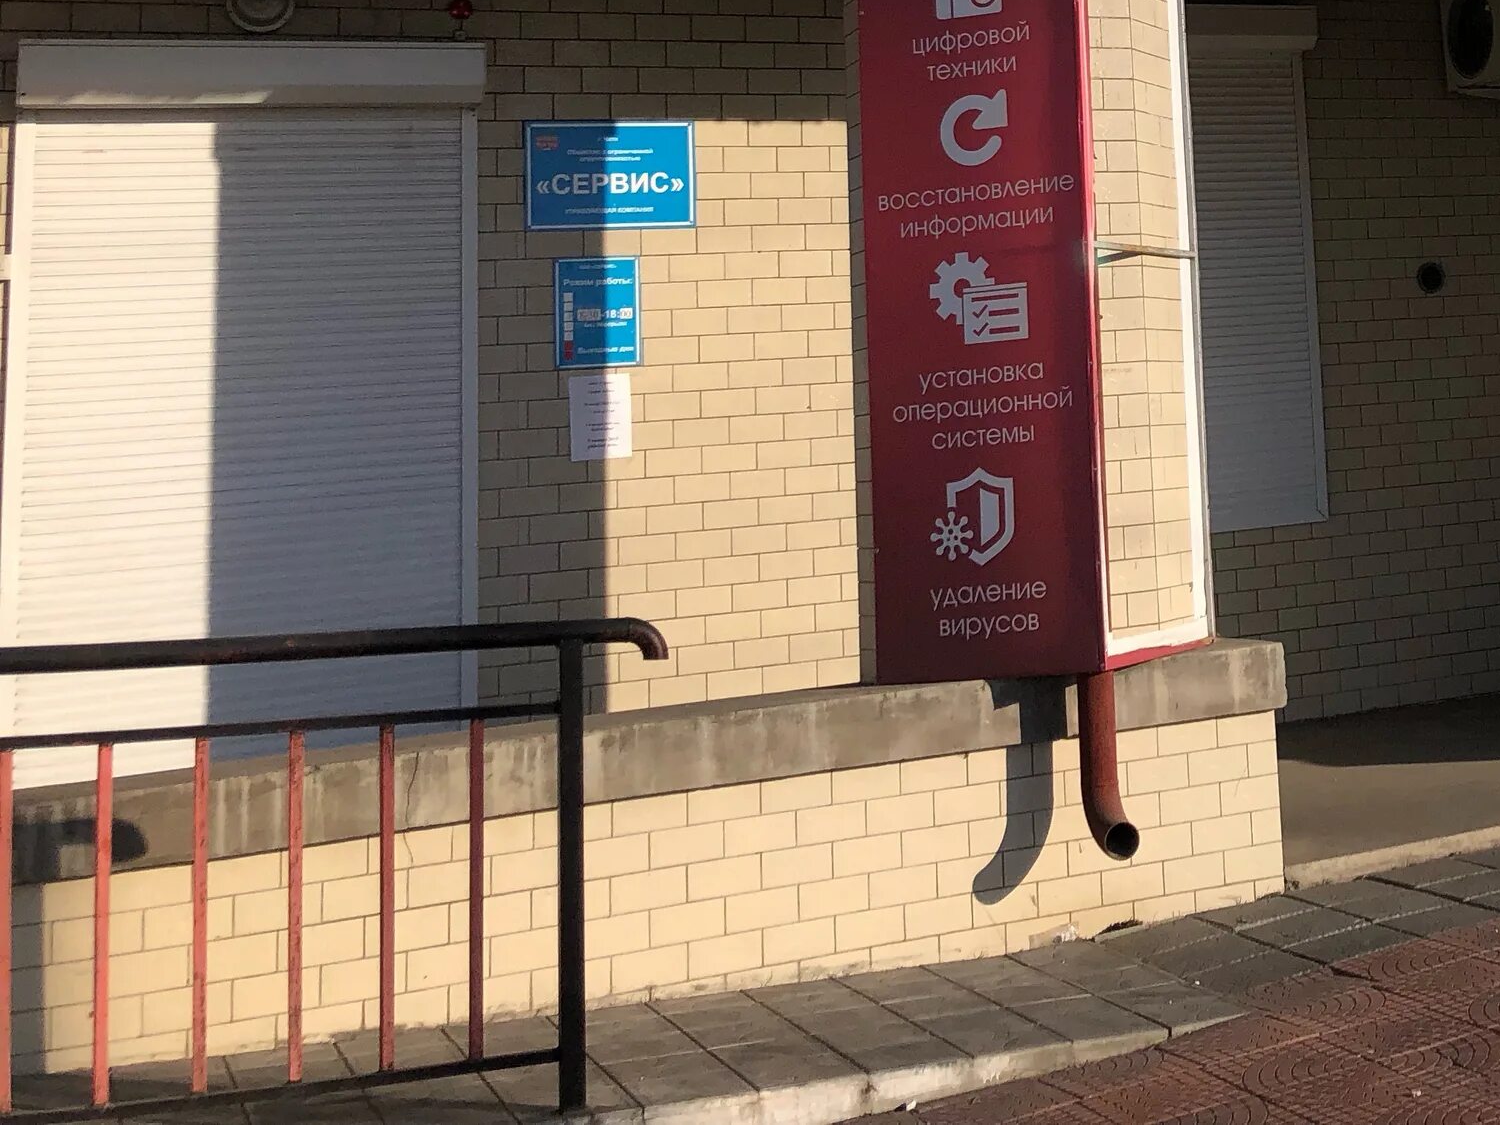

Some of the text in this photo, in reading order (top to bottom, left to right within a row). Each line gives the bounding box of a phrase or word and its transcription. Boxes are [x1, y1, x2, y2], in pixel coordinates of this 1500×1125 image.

[911, 20, 1031, 56] цифровой
[926, 54, 1018, 82] техники
[536, 171, 684, 195] «СЕРВИС»
[878, 173, 1075, 212] восстановление
[900, 205, 1054, 239] информации
[918, 360, 1044, 394] установка
[892, 384, 1074, 424] операционной
[931, 423, 1035, 450] системы
[929, 580, 1047, 611] удаление
[939, 611, 1040, 640] вирусов
